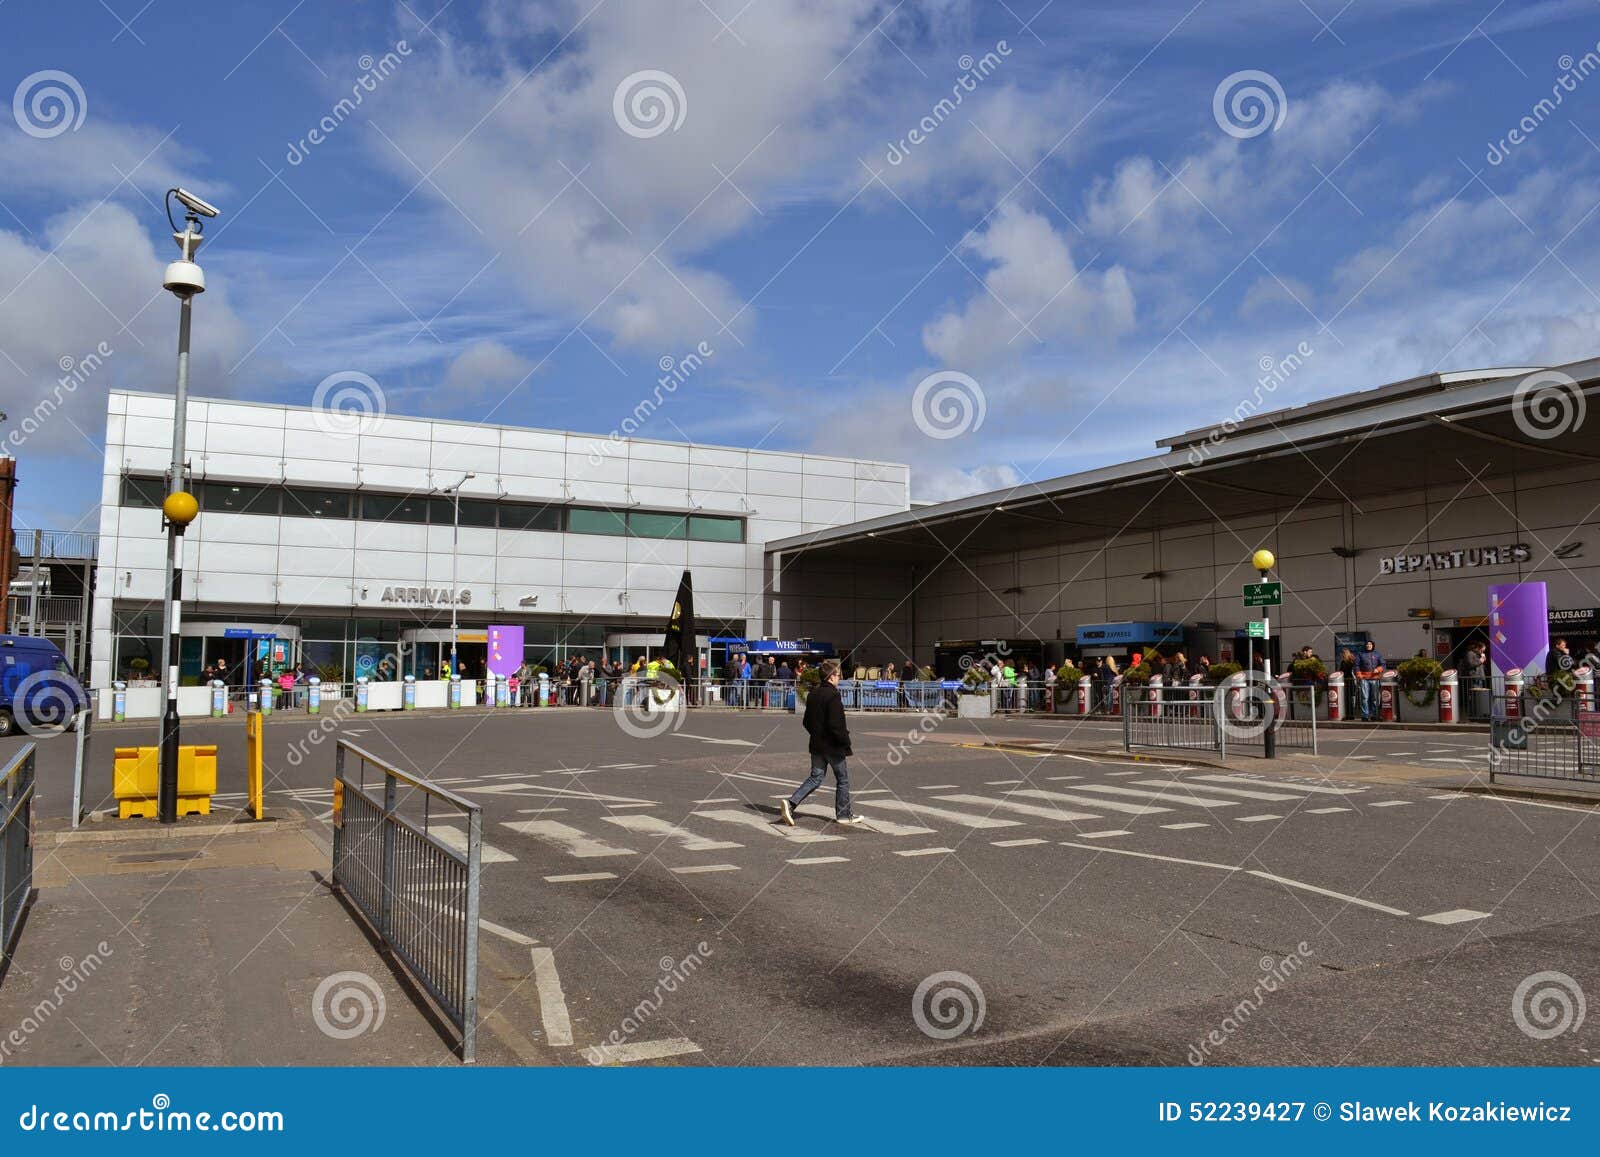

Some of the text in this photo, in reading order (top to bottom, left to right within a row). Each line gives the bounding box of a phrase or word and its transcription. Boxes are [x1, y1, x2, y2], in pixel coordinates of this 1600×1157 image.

[1379, 544, 1530, 575] DEPARTURES
[1549, 610, 1593, 619] SAUSAGE
[775, 641, 810, 650] WHSmith
